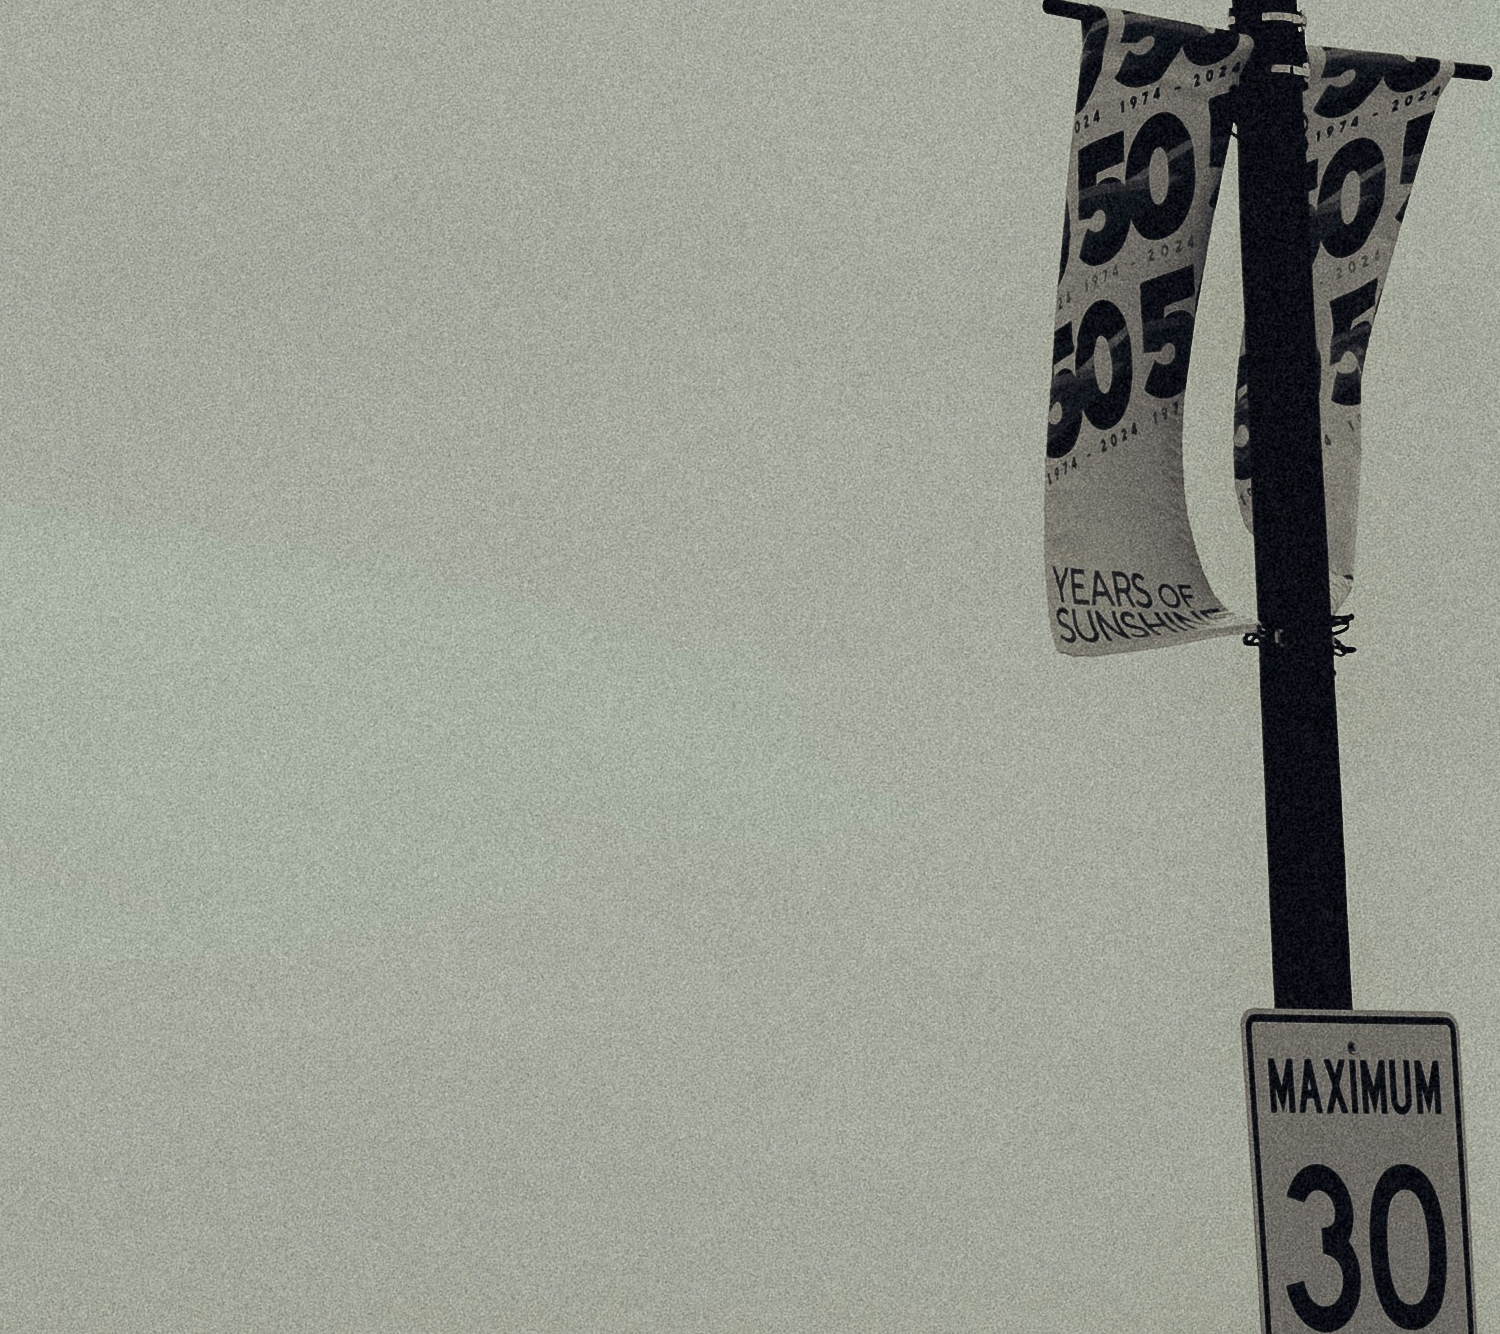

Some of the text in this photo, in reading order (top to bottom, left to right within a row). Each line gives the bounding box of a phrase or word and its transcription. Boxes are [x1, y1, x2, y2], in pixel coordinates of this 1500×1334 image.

[1119, 86, 1161, 114] 1974
[1193, 61, 1241, 88] 2024
[1316, 115, 1359, 143] 1974
[1391, 85, 1441, 113] 2024
[1077, 111, 1196, 267] 50
[1084, 264, 1119, 293] 1974
[1147, 234, 1195, 262] 2024
[1336, 249, 1380, 279] 2024
[1047, 299, 1133, 459] 50
[1047, 456, 1078, 485] 1974
[1100, 422, 1138, 453] 2024
[1052, 566, 1194, 609] YEARS OF
[1267, 1058, 1442, 1114] MAXIMUM
[1286, 1164, 1447, 1333] 30
